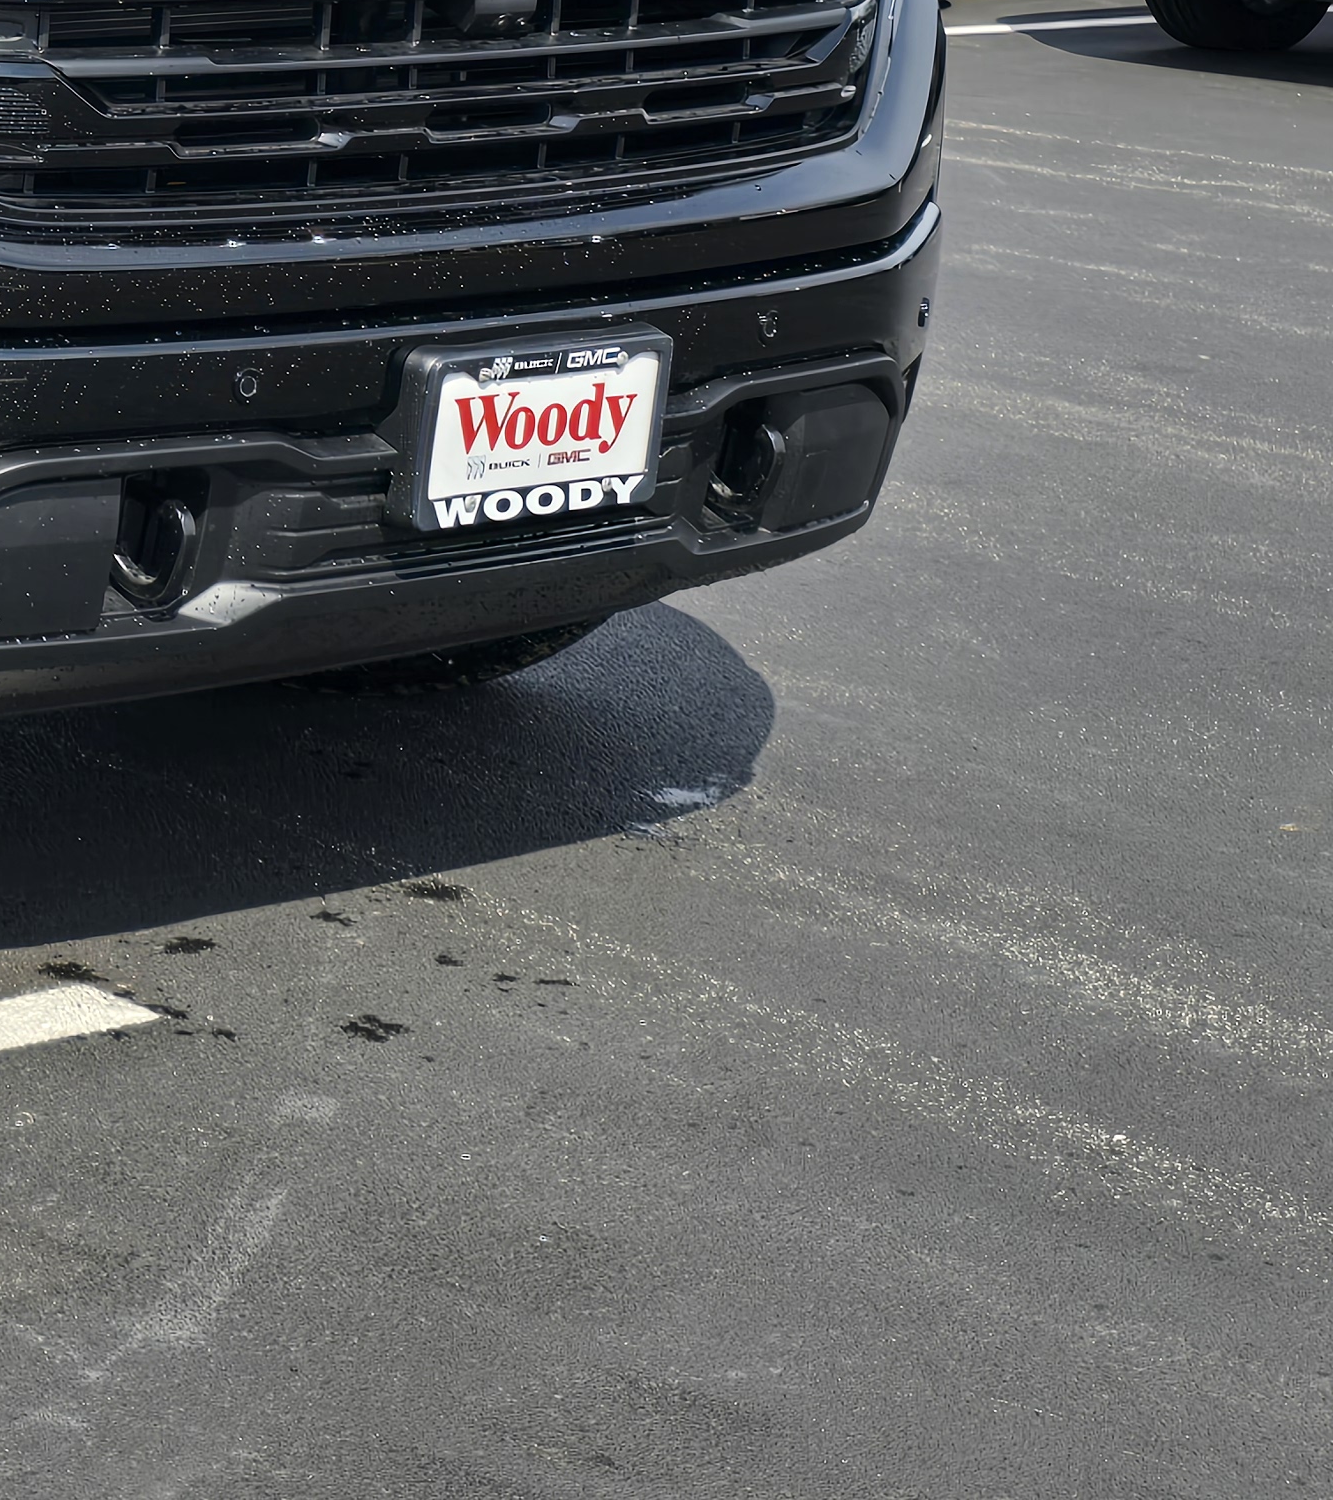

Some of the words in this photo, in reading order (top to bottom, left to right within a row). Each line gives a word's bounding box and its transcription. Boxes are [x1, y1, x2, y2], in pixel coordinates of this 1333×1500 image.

[514, 357, 554, 370] BUICK
[566, 347, 622, 369] GMC
[454, 382, 638, 455] Woody
[488, 458, 531, 470] BUICK
[547, 449, 592, 466] GMC
[432, 474, 645, 529] WOODY
